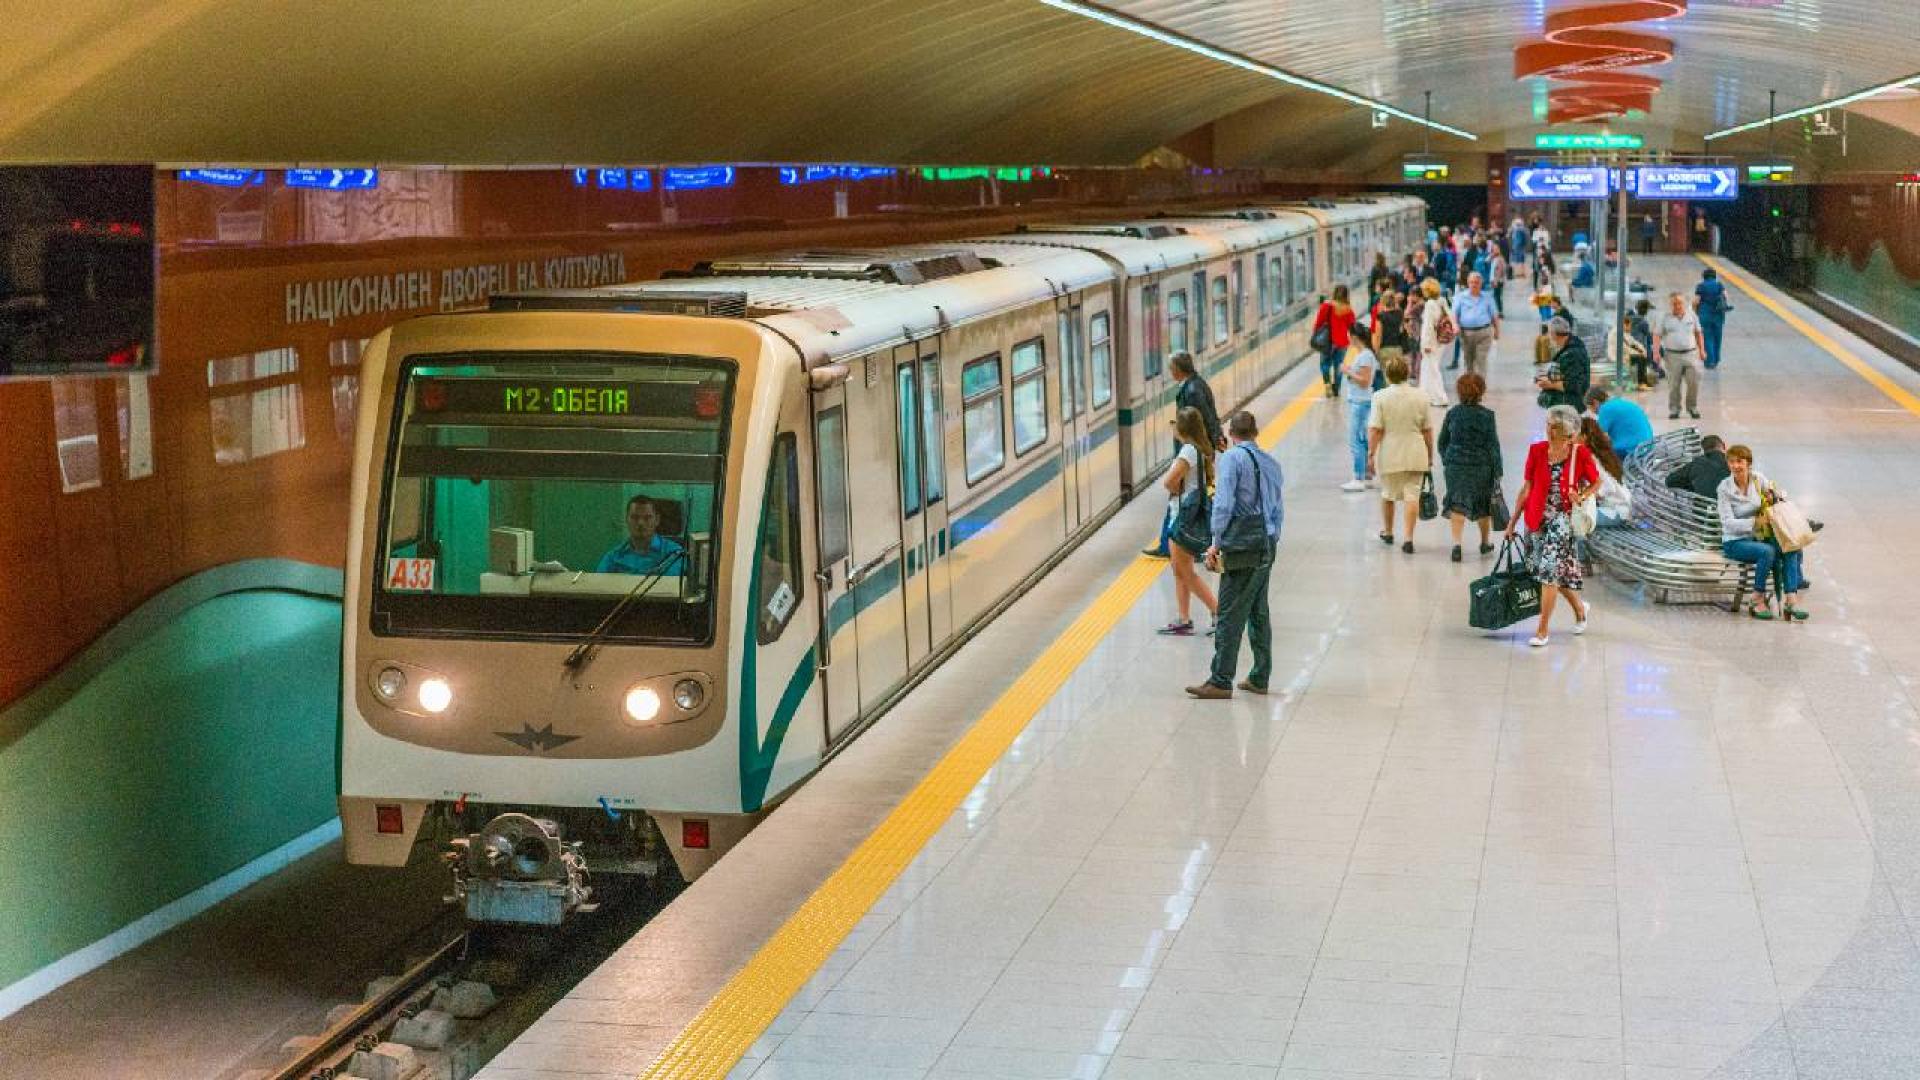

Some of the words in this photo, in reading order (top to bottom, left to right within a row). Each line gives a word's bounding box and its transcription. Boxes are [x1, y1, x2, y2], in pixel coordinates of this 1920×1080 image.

[285, 269, 432, 327] НАЦИОНАЛЕН
[439, 264, 509, 313] ДВОРЕЦ
[517, 260, 539, 291] НА
[544, 250, 625, 288] КУЛТУРАТА
